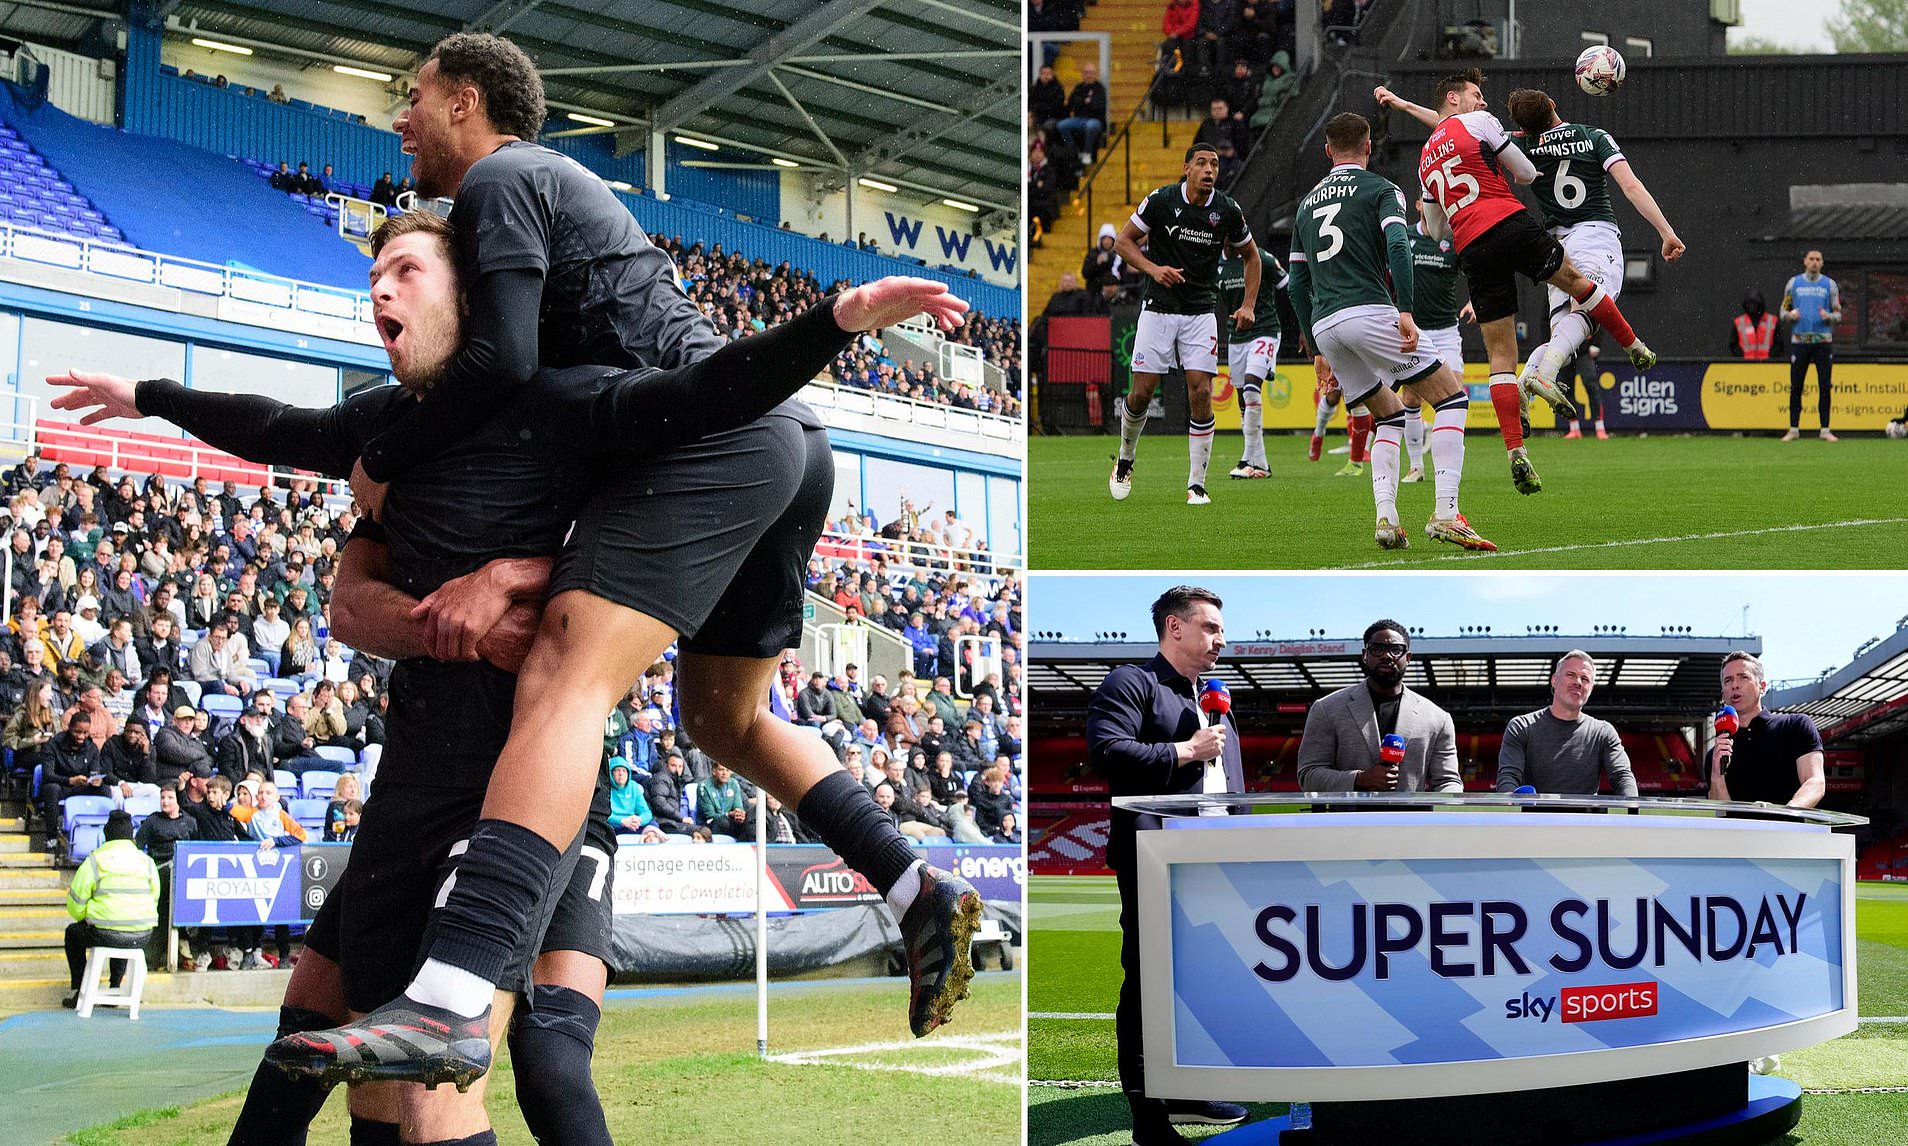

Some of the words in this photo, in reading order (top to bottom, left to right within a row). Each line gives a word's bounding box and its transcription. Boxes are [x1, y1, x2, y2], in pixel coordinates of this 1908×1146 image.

[1421, 138, 1455, 172] COLLINS
[1425, 154, 1480, 219] 25
[1554, 160, 1587, 209] 6
[1303, 185, 1358, 210] MURPHY
[1178, 233, 1212, 246] plumbing
[1180, 227, 1213, 239] victorian
[1312, 203, 1344, 263] 3
[1414, 253, 1445, 261] victorian
[1254, 340, 1275, 358] 28
[1620, 376, 1675, 397] allen
[1714, 381, 1768, 396] Signage.
[1620, 398, 1678, 417] signs
[1233, 645, 1247, 655] Sir
[1248, 645, 1277, 656] Kenny
[1318, 643, 1345, 653] Stand
[625, 856, 683, 876] signage
[961, 856, 1022, 885] energ
[187, 853, 295, 925] TV
[206, 881, 271, 897] ROYALS
[658, 886, 673, 900] to
[680, 879, 758, 906] Completio
[1253, 901, 1532, 982] SUPER
[1548, 892, 1807, 974] SUNDAY
[1506, 991, 1556, 1023] sky
[1566, 988, 1653, 1019] sports
